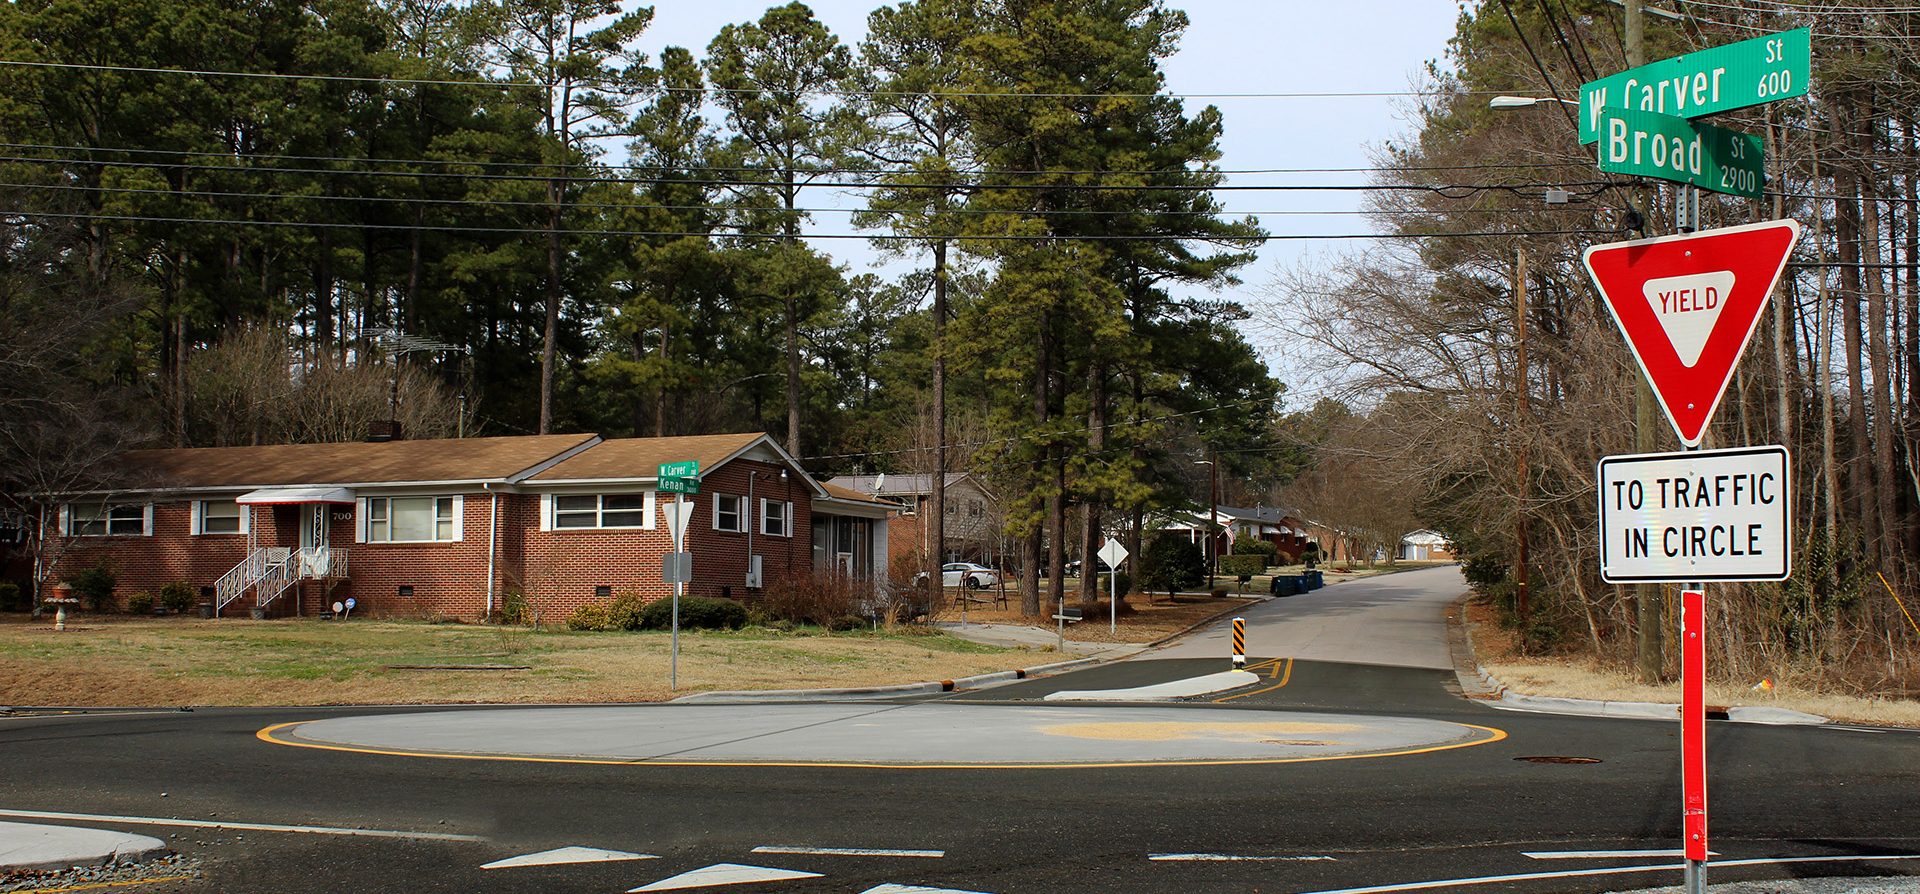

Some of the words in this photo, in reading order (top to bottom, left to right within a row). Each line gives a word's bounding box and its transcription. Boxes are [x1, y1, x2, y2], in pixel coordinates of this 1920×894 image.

[1765, 38, 1783, 64] St
[1624, 67, 1725, 113] Carver
[1757, 69, 1791, 98] 600
[1609, 117, 1701, 175] Broad
[1731, 135, 1745, 159] St
[1721, 165, 1755, 192] 2900
[1658, 286, 1719, 314] YIELD
[667, 465, 686, 476] Carver
[660, 478, 684, 491] Kenan
[1612, 478, 1644, 511] TO
[1656, 472, 1775, 509] TRAFFIC
[333, 512, 352, 520] 700
[1624, 527, 1649, 558] IN
[1663, 523, 1763, 557] CIRCLE
